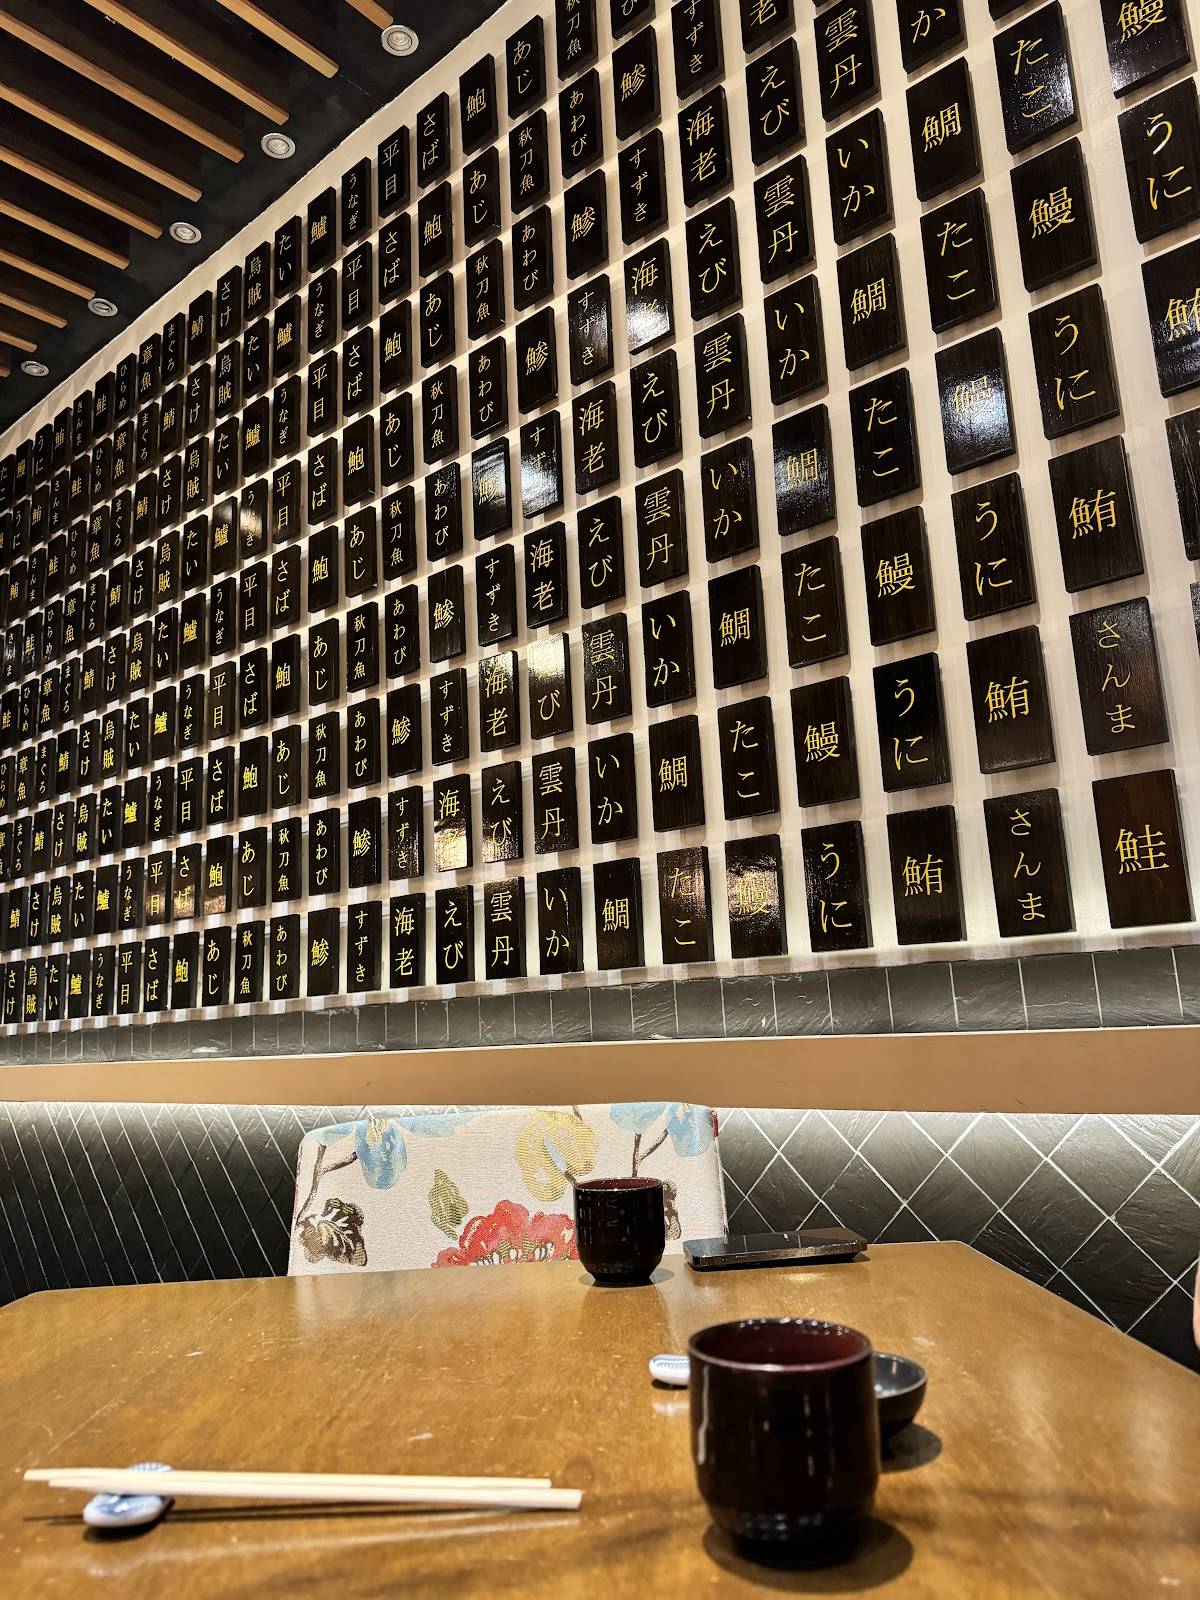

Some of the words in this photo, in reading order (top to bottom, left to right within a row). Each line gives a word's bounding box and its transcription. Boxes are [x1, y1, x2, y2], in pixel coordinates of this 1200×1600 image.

[514, 41, 532, 94] あじ
[825, 8, 862, 98] 雲丹
[1010, 36, 1049, 119] たこ
[466, 88, 486, 121] 鮑
[570, 91, 587, 156] あわび
[760, 66, 789, 136] えび
[921, 102, 961, 152] 鯛
[383, 139, 399, 200] 平目
[423, 113, 439, 170] さば
[519, 127, 534, 195] 秋刀魚
[686, 106, 717, 182] 海老
[1146, 113, 1192, 210] うに
[348, 173, 359, 229] うなぎ
[470, 170, 487, 223] あじ
[629, 148, 648, 222] すずき
[837, 139, 875, 218] いか
[424, 214, 442, 246] 鮑
[764, 175, 799, 263] 雲丹
[1029, 187, 1075, 239] 鰻
[346, 254, 362, 314] 平目
[384, 232, 400, 288] さば
[475, 255, 490, 323] 秋刀魚
[522, 225, 538, 291] あわび
[698, 224, 727, 293] えび
[937, 222, 976, 300] たこ
[220, 282, 231, 327] さけ
[314, 283, 324, 338] うなぎ
[425, 293, 442, 347] あじ
[578, 292, 597, 365] すずき
[850, 278, 886, 324] 鯛
[247, 336, 259, 381] たい
[347, 345, 363, 400] さば
[384, 332, 402, 362] 鮑
[774, 302, 810, 380] いか
[1054, 315, 1096, 411] うに
[312, 363, 327, 422] 平目
[477, 352, 493, 421] あわび
[642, 373, 668, 443] えび
[703, 332, 735, 419] 雲丹
[385, 412, 401, 467] あじ
[430, 381, 444, 448] 秋刀魚
[578, 399, 605, 473] 海老
[864, 398, 899, 477] たこ
[217, 433, 229, 479] たい
[312, 454, 327, 510] さば
[348, 446, 365, 476] 鮑
[786, 448, 818, 490] 鯛
[277, 470, 292, 528] 平目
[434, 474, 450, 546] あわび
[646, 483, 677, 566] 雲丹
[711, 462, 744, 537] いか
[1069, 489, 1116, 539] 鮪
[350, 525, 365, 580] あじ
[389, 500, 403, 566] 秋刀魚
[588, 518, 612, 587] えび
[974, 502, 1013, 596] うに
[243, 573, 258, 630] 平目
[276, 560, 290, 615] さば
[312, 555, 328, 584] 鮑
[485, 558, 501, 632] すずき
[530, 539, 555, 611] 海老
[794, 563, 827, 642] たこ
[875, 552, 915, 598] 鰻
[215, 588, 224, 644] うなぎ
[354, 614, 366, 680] 秋刀魚
[393, 599, 406, 665] あわび
[653, 612, 683, 685] いか
[719, 608, 750, 647] 鯛
[244, 662, 258, 717] さば
[313, 635, 328, 690] あじ
[592, 625, 620, 707] 雲丹
[1098, 620, 1136, 733] さんま
[212, 672, 226, 728] 平目
[440, 680, 455, 754] すずき
[483, 667, 507, 738] 海老
[893, 679, 928, 770] うに
[984, 676, 1029, 723] 鮪
[276, 740, 290, 795] あじ
[315, 723, 327, 788] 秋刀魚
[355, 711, 367, 777] あわび
[658, 756, 687, 792] 鯛
[730, 720, 760, 798] たこ
[804, 721, 840, 762] 鰻
[210, 759, 224, 813] さば
[489, 779, 511, 849] えび
[540, 761, 566, 840] 雲丹
[595, 755, 623, 825] いか
[278, 827, 290, 892] 秋刀魚
[316, 819, 328, 885] あわび
[396, 799, 411, 872] すずき
[1010, 808, 1045, 921] さんま
[1115, 825, 1170, 875] 鮭
[241, 841, 255, 897] あじ
[820, 843, 852, 932] うに
[902, 854, 943, 897] 鮪
[443, 900, 464, 969] えび
[490, 892, 514, 967] 雲丹
[543, 887, 569, 957] いか
[602, 897, 629, 932] 鯛
[667, 866, 695, 944] たこ
[207, 939, 220, 995] あじ
[240, 930, 252, 994] 秋刀魚
[276, 925, 287, 991] あわび
[355, 910, 368, 982] すずき
[394, 907, 415, 976] 海老
